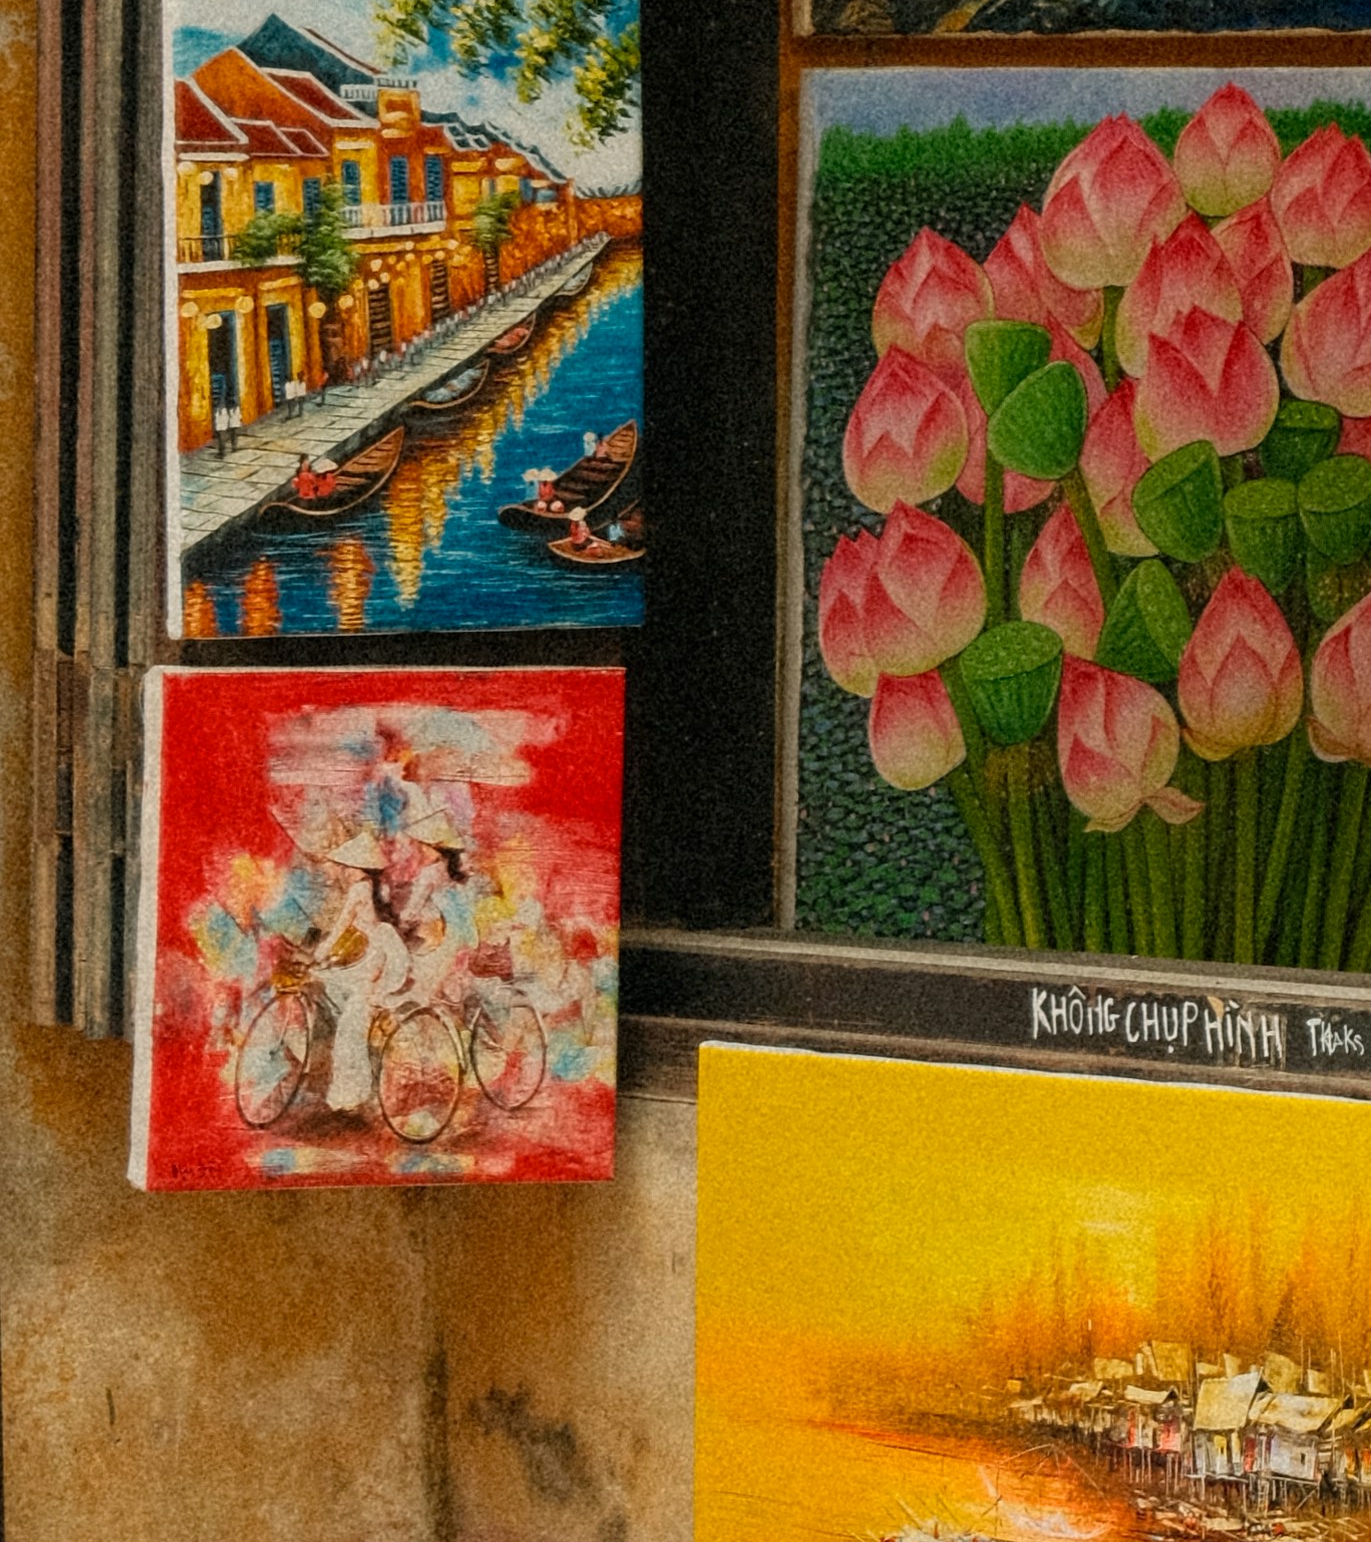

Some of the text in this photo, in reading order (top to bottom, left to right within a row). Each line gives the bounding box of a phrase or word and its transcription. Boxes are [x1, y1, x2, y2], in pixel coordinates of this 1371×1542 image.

[1030, 984, 1122, 1042] KHÔNG
[1124, 1000, 1200, 1055] CHỤP
[1203, 998, 1286, 1061] HÌNH
